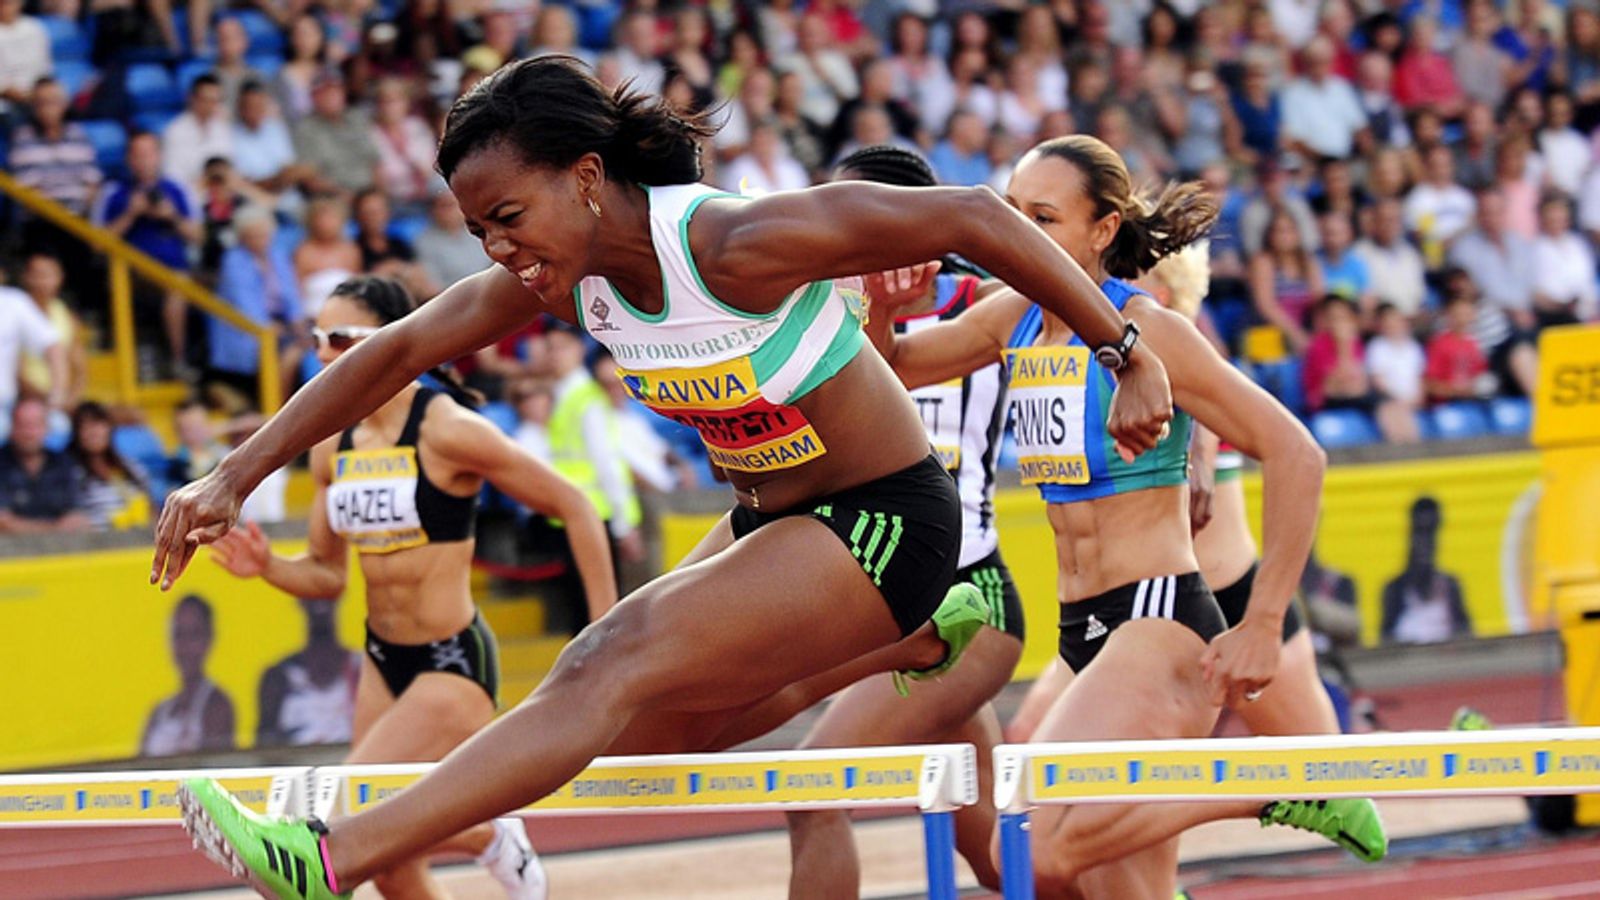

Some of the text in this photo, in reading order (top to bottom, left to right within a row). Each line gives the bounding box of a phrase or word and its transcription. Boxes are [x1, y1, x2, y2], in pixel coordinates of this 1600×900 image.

[1019, 356, 1078, 379] AVIVA
[657, 373, 748, 403] AVIVA
[353, 455, 409, 474] AVIVA
[336, 487, 403, 526] HAZEL
[573, 776, 677, 798] BIRMINGHAM
[708, 776, 756, 792] AVIVA
[786, 772, 835, 788] AVIVA
[865, 768, 914, 785] AVIVA
[1068, 766, 1118, 782] AVIVA
[1151, 764, 1202, 781] AVIVA
[1236, 763, 1290, 780] AVIVA
[1304, 758, 1428, 782] BIRMINGHAM
[1467, 756, 1523, 773] AVIVA
